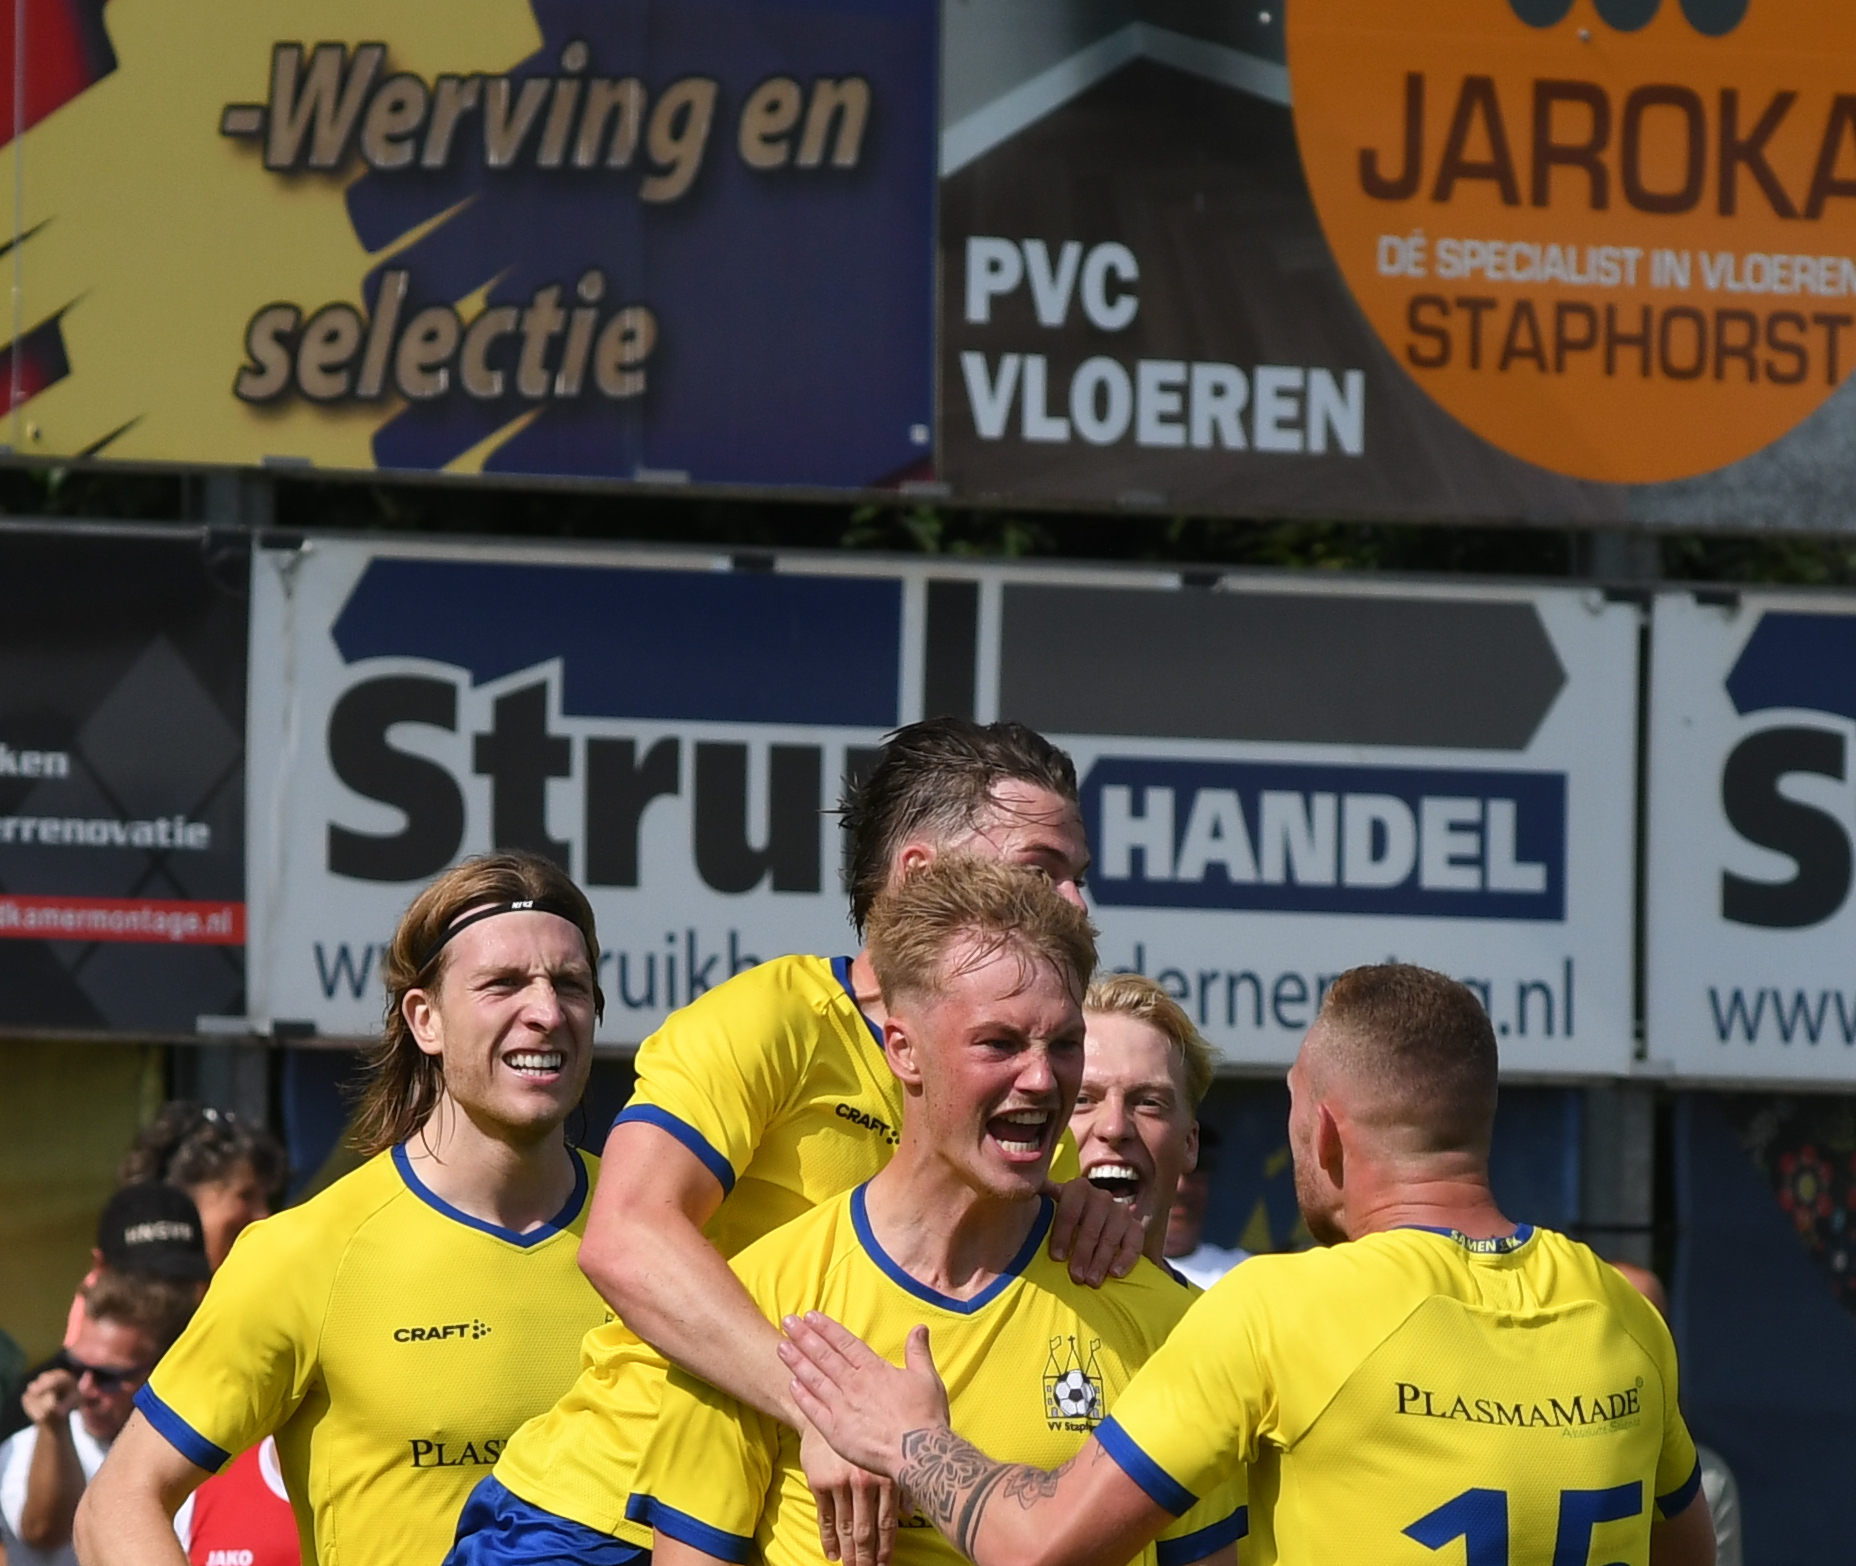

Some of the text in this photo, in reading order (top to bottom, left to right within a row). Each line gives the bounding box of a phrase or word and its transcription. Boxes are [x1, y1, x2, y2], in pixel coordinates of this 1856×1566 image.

[222, 41, 868, 202] -Werving en
[966, 237, 1138, 330] PVC
[1378, 231, 1426, 276] DÉ
[1439, 239, 1641, 287] SPECIALIST
[1652, 250, 1692, 290] IN
[234, 270, 656, 400] selectie
[1406, 294, 1853, 385] STAPHORST
[961, 352, 1364, 456] VLOEREN
[1100, 784, 1547, 893] HANDEL
[835, 1103, 891, 1136] CRAFT
[1451, 1229, 1497, 1252] SAMEN
[394, 1324, 470, 1342] CRAFT
[408, 1439, 508, 1467] PLAS
